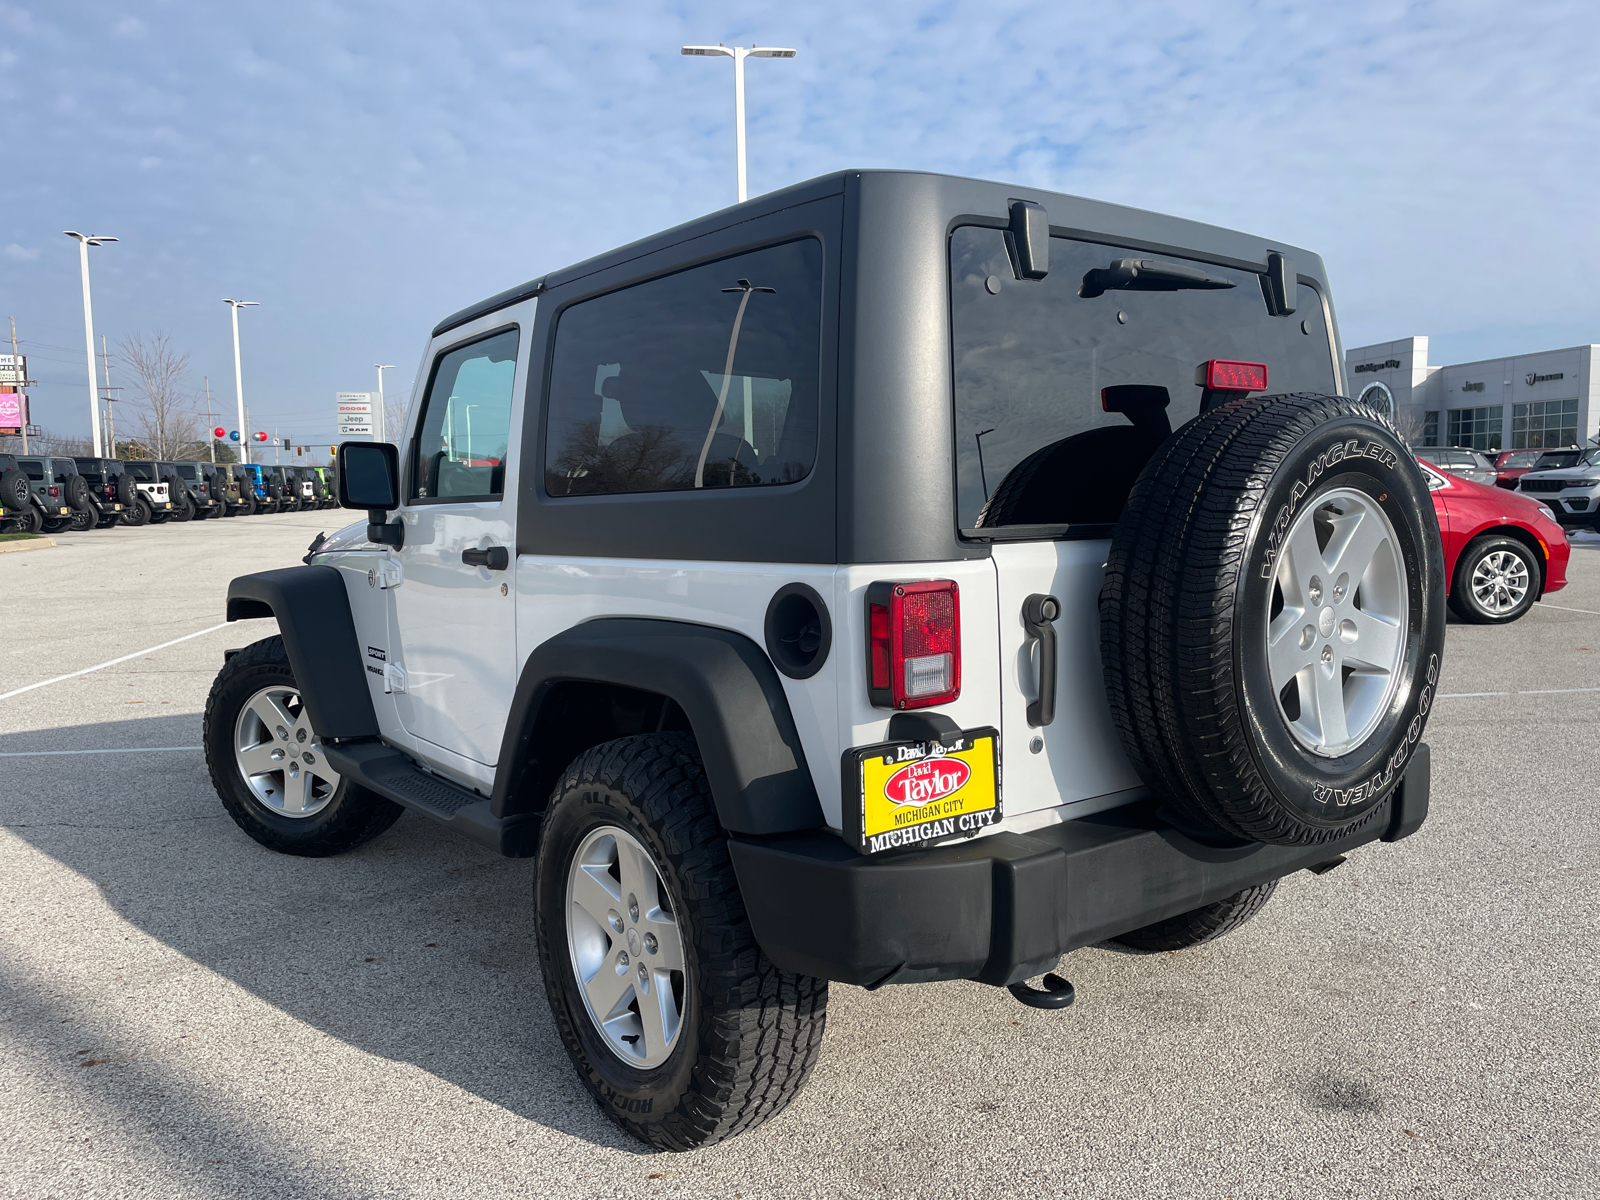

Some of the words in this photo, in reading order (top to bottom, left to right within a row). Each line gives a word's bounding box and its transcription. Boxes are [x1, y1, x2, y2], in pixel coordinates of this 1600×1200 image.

[1462, 380, 1485, 392] Jeep
[344, 415, 364, 423] Jeep
[1261, 439, 1398, 579] WRANGLER
[368, 648, 386, 659] SPORT
[366, 665, 384, 676] WRANGL
[1313, 652, 1439, 806] GOODYEAR
[897, 742, 926, 761] David
[907, 763, 931, 778] David
[898, 769, 962, 803] Taylor
[581, 791, 615, 808] ALL
[894, 805, 941, 826] MICHIGAN
[943, 798, 965, 814] CITY
[871, 818, 955, 853] MICHIGAN
[958, 810, 996, 831] CITY
[596, 1079, 654, 1114] ROCKY
